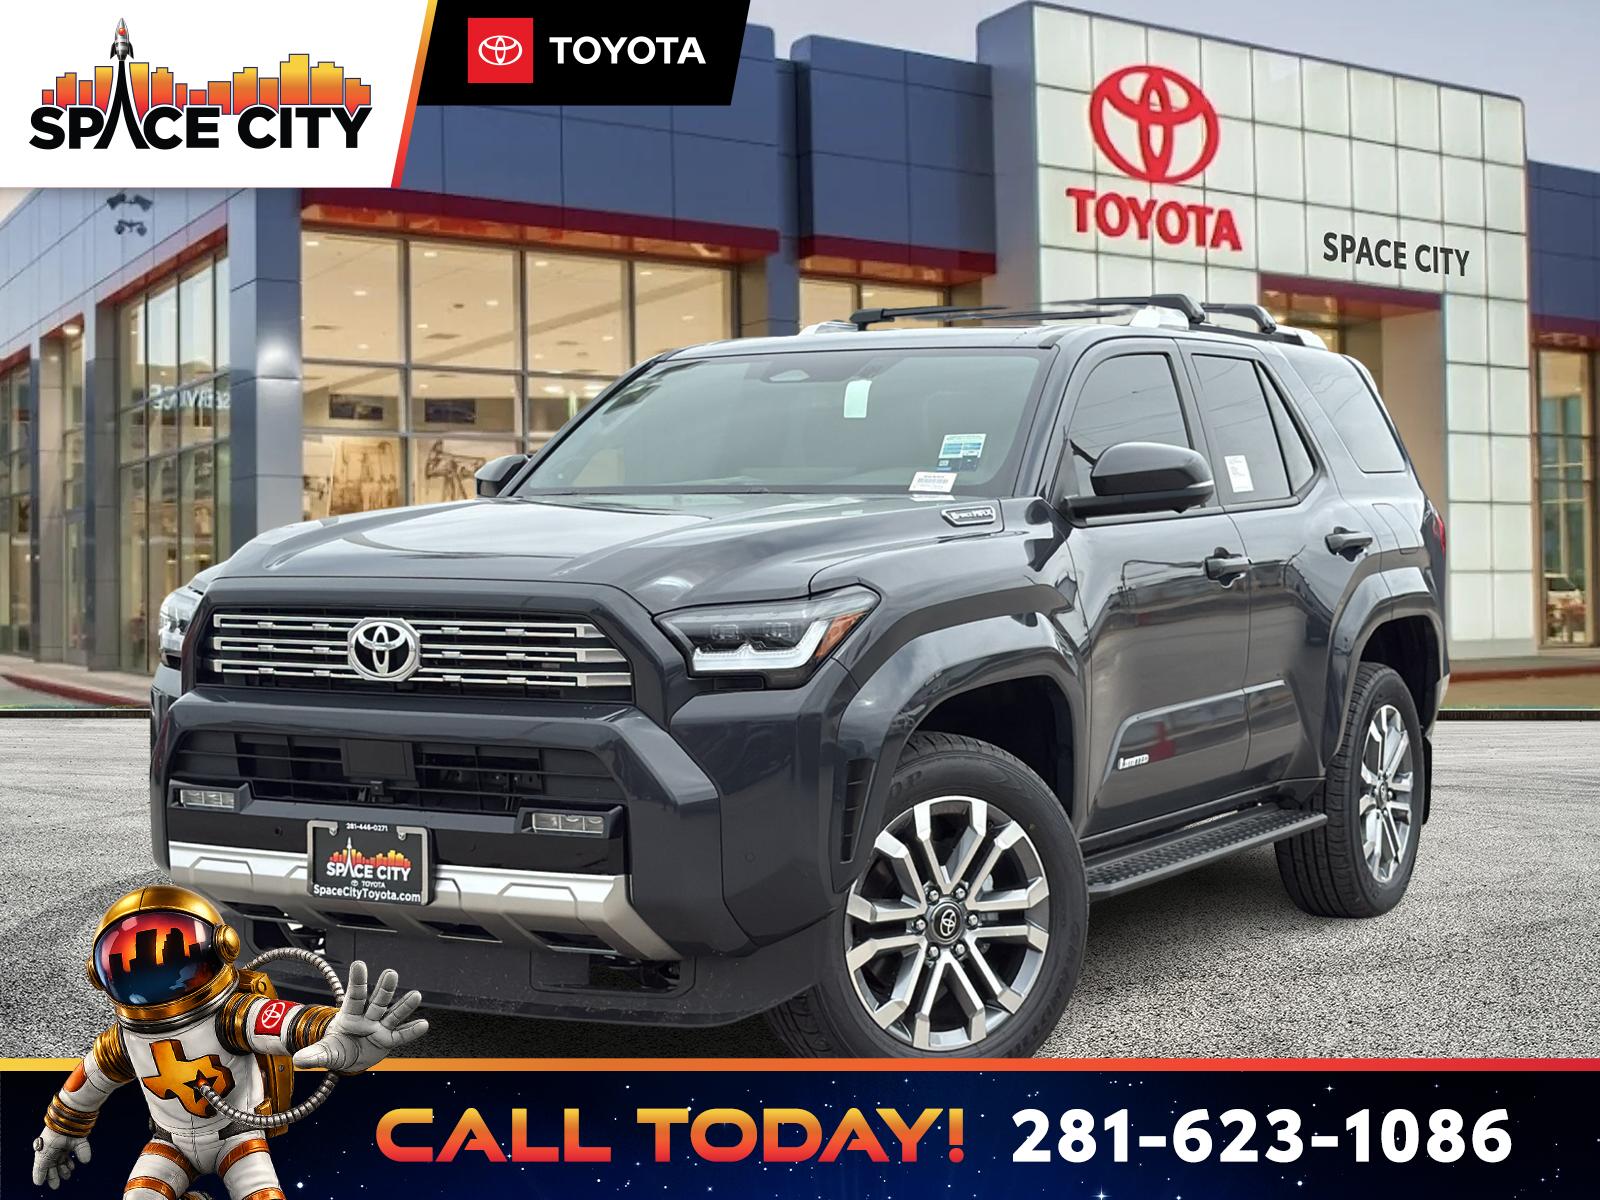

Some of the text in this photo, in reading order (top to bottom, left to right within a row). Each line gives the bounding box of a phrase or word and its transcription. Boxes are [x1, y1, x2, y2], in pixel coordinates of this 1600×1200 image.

[1065, 187, 1243, 251] TOYOTA
[1323, 231, 1470, 277] SPACE CITY
[326, 861, 411, 881] SPACE CITY
[313, 884, 421, 902] SpaceCityToyota.com
[361, 880, 386, 889] TOYOTA
